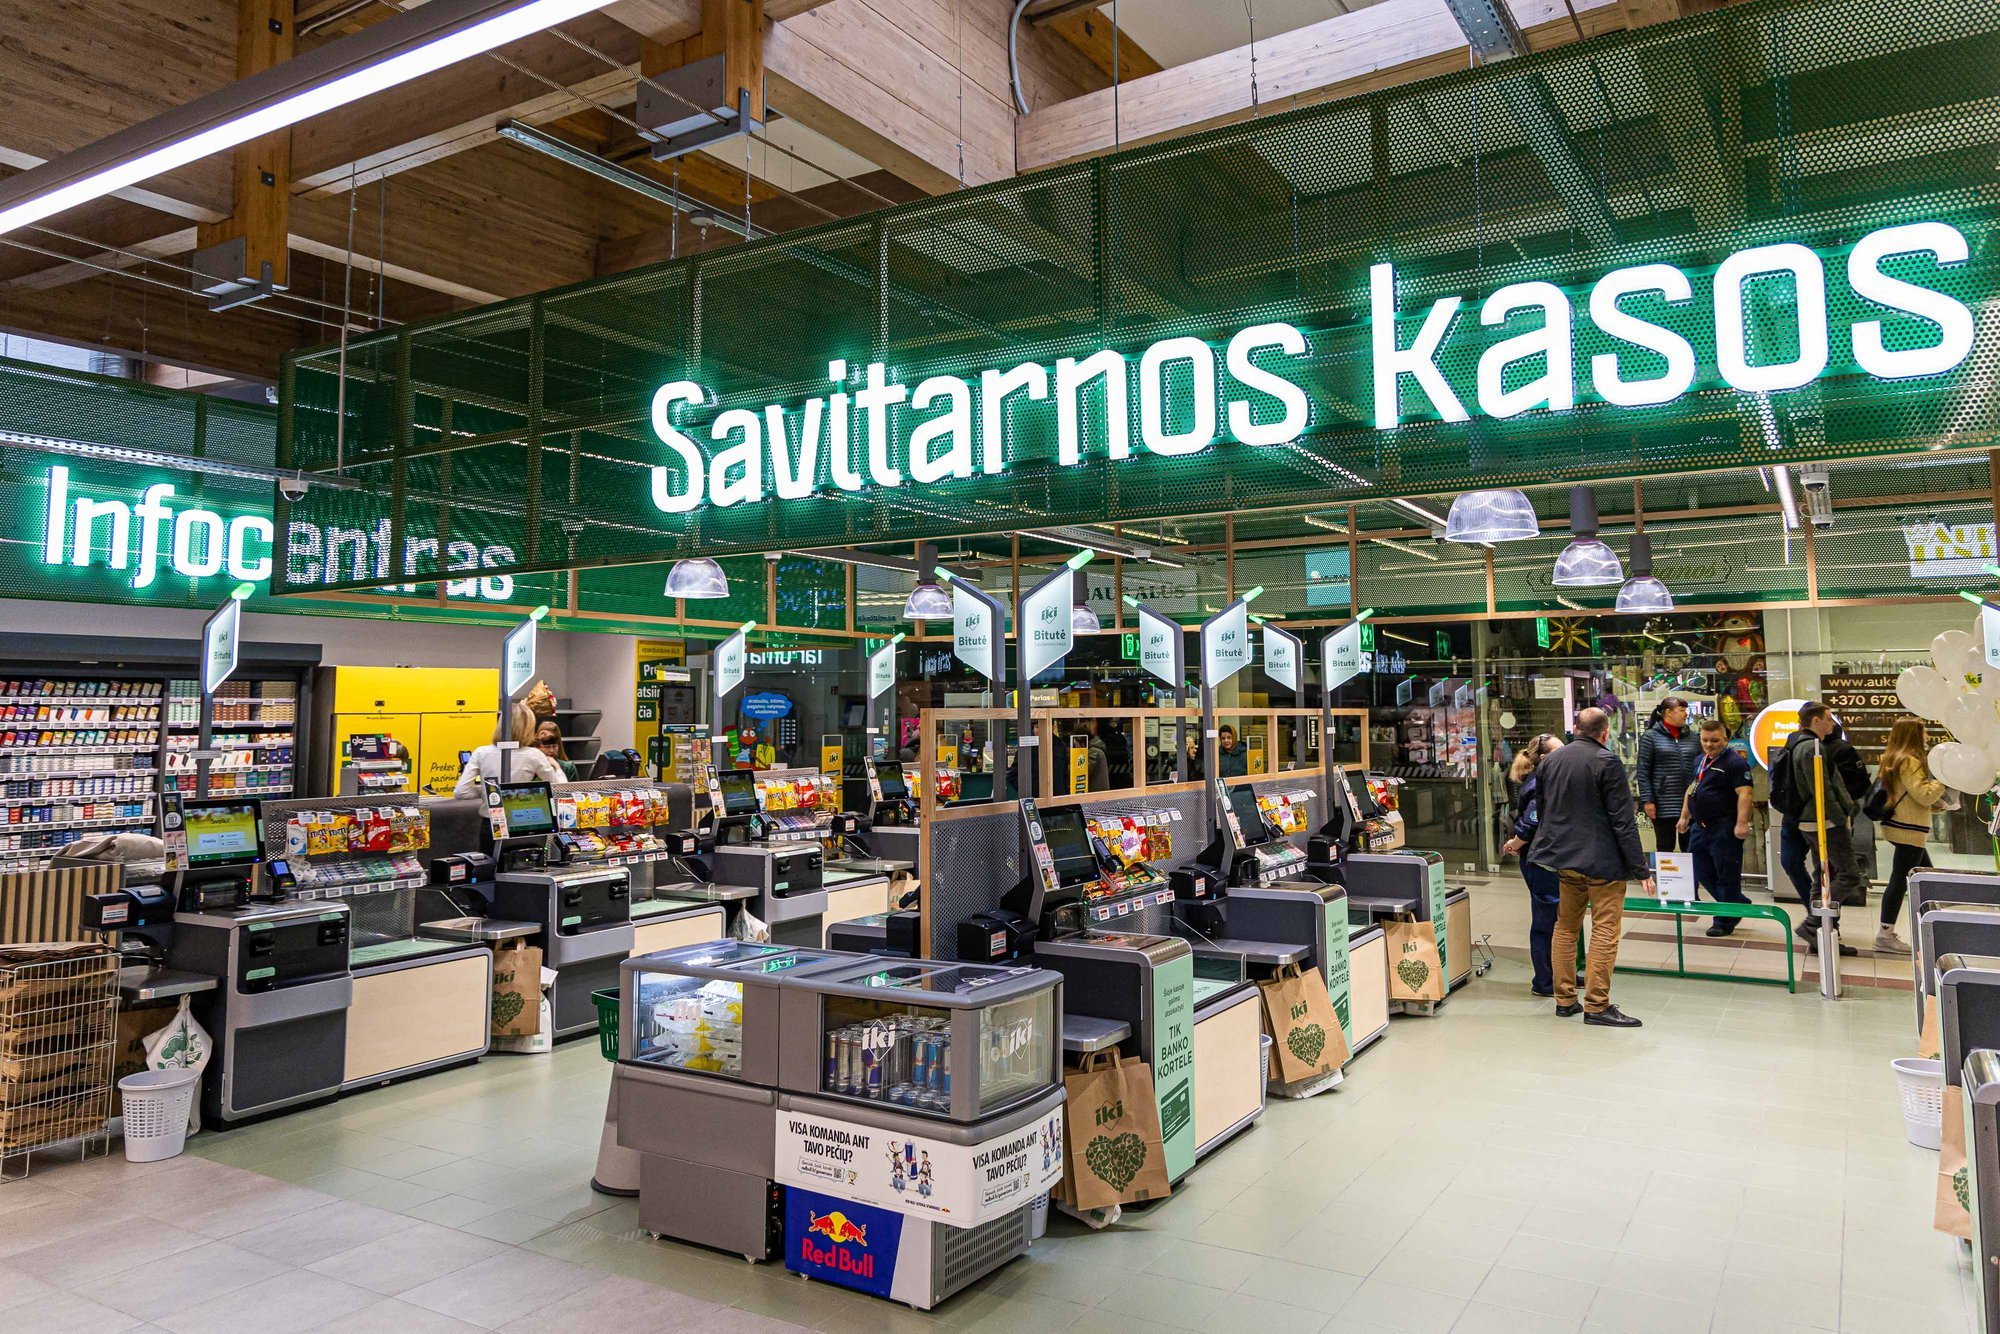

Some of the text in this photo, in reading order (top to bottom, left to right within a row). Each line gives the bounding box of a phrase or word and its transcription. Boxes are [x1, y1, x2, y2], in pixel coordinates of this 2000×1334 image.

[650, 218, 1976, 515] Savitarnos kasos
[44, 465, 517, 602] Infocentras
[966, 614, 980, 628] iki
[1042, 606, 1058, 621] iki
[958, 635, 987, 647] Bitutė
[1034, 629, 1066, 641] Bitutė
[1151, 634, 1164, 645] iki
[1221, 630, 1235, 641] iki
[1145, 651, 1170, 660] Bitutė
[1215, 648, 1243, 657] Bitutė
[1274, 647, 1285, 656] iki
[1337, 645, 1349, 655] iki
[1268, 661, 1291, 669] Bitutė
[1333, 659, 1356, 667] Bitutė
[1828, 676, 1898, 688] www.auks
[1830, 694, 1898, 707] +370 679
[638, 704, 652, 719] čia
[1335, 948, 1343, 960] TIK
[1403, 943, 1417, 955] iki
[1331, 959, 1347, 976] BANKO
[1329, 970, 1349, 990] KORTELE
[1290, 1000, 1310, 1021] iki
[862, 1022, 896, 1052] iki
[1010, 1017, 1033, 1055] iki
[1168, 1022, 1182, 1040] TIK
[1161, 1036, 1189, 1061] BANKO
[1157, 1050, 1193, 1081] KORTELE
[1095, 1100, 1124, 1126] iki
[789, 1120, 870, 1150] VISA KOMANDA ANT
[803, 1139, 853, 1164] TAVO PEČIŲ?
[972, 1131, 1038, 1170] VISA KOMANDA ANT
[986, 1153, 1028, 1182] TAVO PEČIŲ?
[802, 1237, 874, 1278] Red Bull
